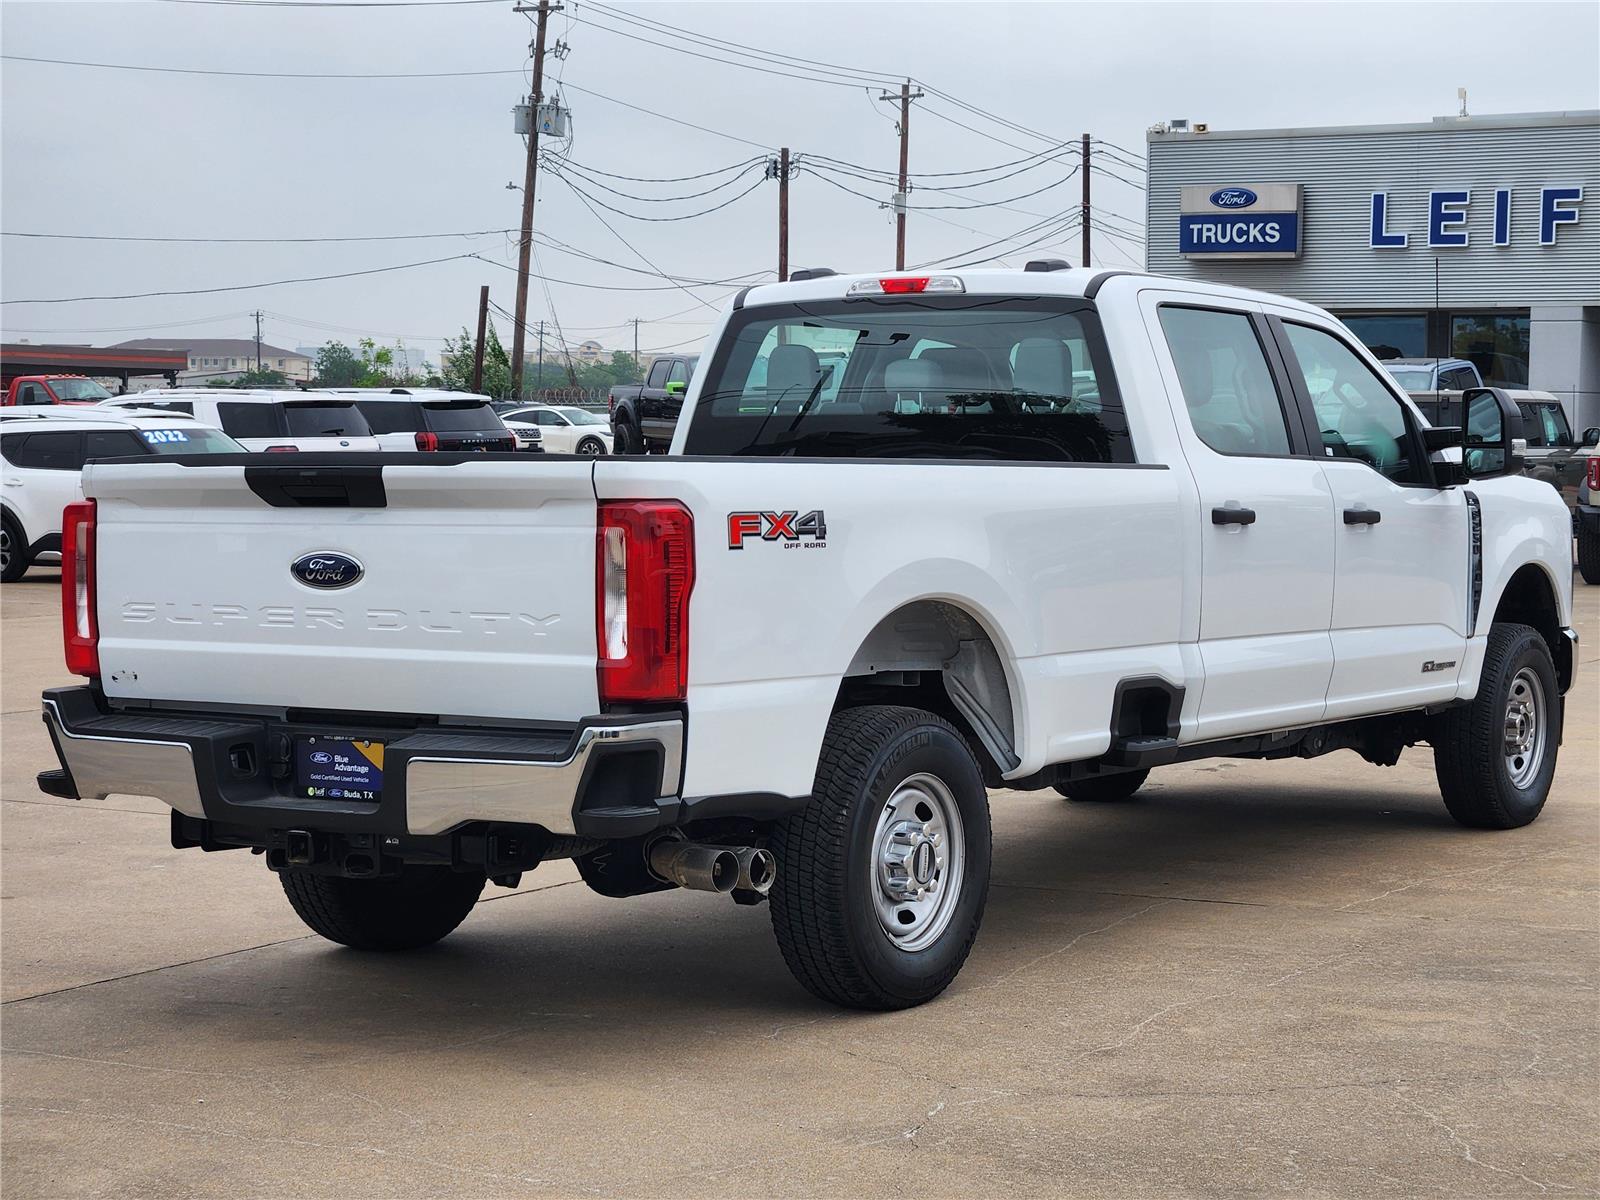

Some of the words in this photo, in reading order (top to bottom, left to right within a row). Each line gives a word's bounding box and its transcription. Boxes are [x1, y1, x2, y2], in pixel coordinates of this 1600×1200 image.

[1218, 191, 1247, 205] Ford
[1370, 186, 1583, 249] LEIF
[1189, 222, 1281, 244] TRUCKS
[143, 430, 188, 444] 2022
[727, 510, 827, 551] FX4
[783, 542, 801, 550] OFF
[803, 541, 827, 549] ROAD
[305, 558, 346, 581] Ford
[122, 601, 345, 630] SUPER
[367, 608, 561, 636] DUTY
[334, 754, 349, 763] Blue
[334, 763, 369, 774] Advantage
[343, 790, 362, 799] Buda,
[363, 791, 374, 799] TX
